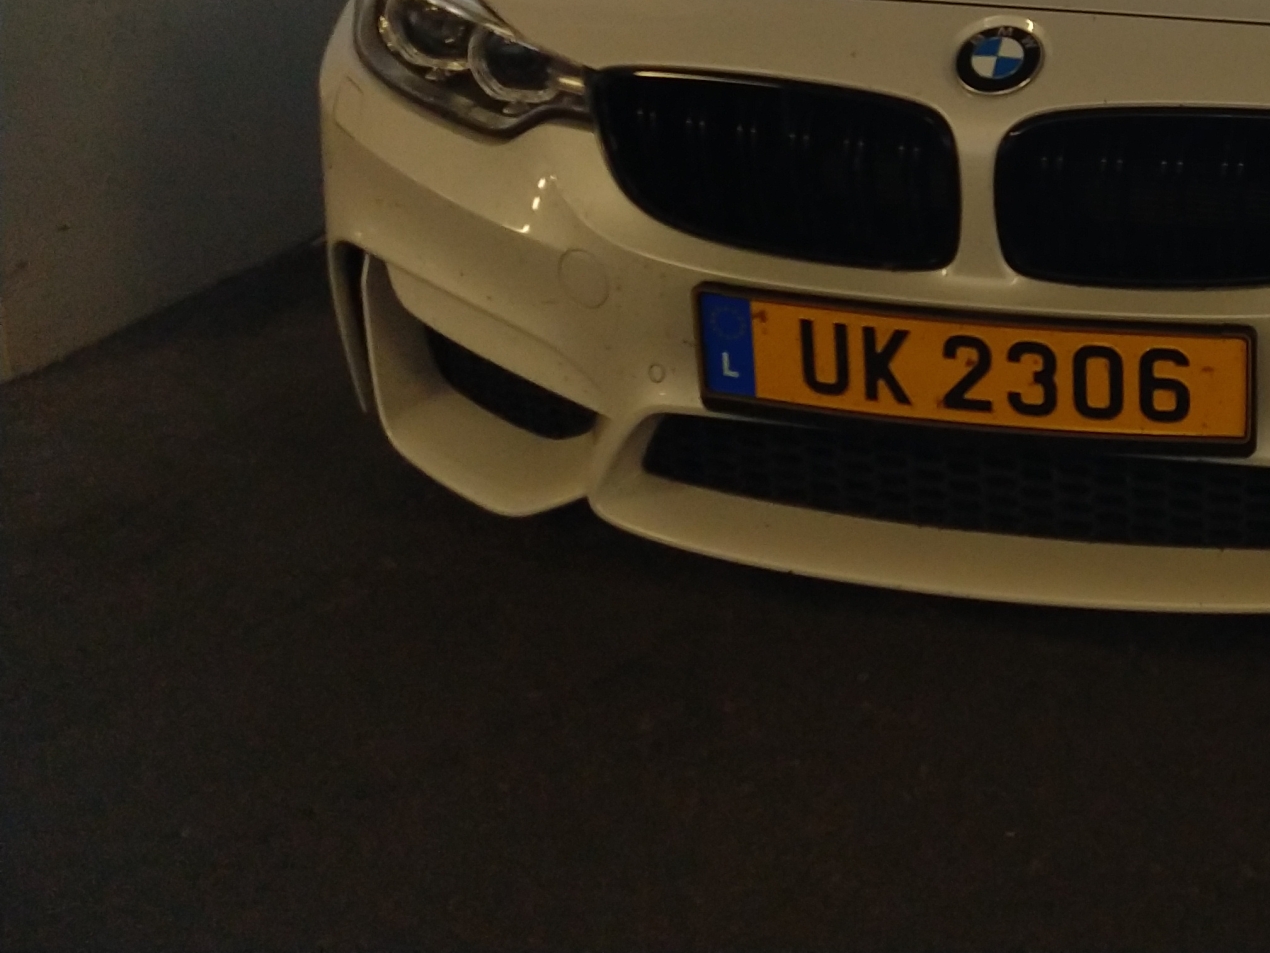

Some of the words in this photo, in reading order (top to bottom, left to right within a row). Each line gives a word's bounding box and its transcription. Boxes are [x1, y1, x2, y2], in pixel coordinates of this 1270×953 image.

[721, 352, 740, 379] L
[800, 319, 912, 406] UK
[942, 334, 1191, 424] 2306
